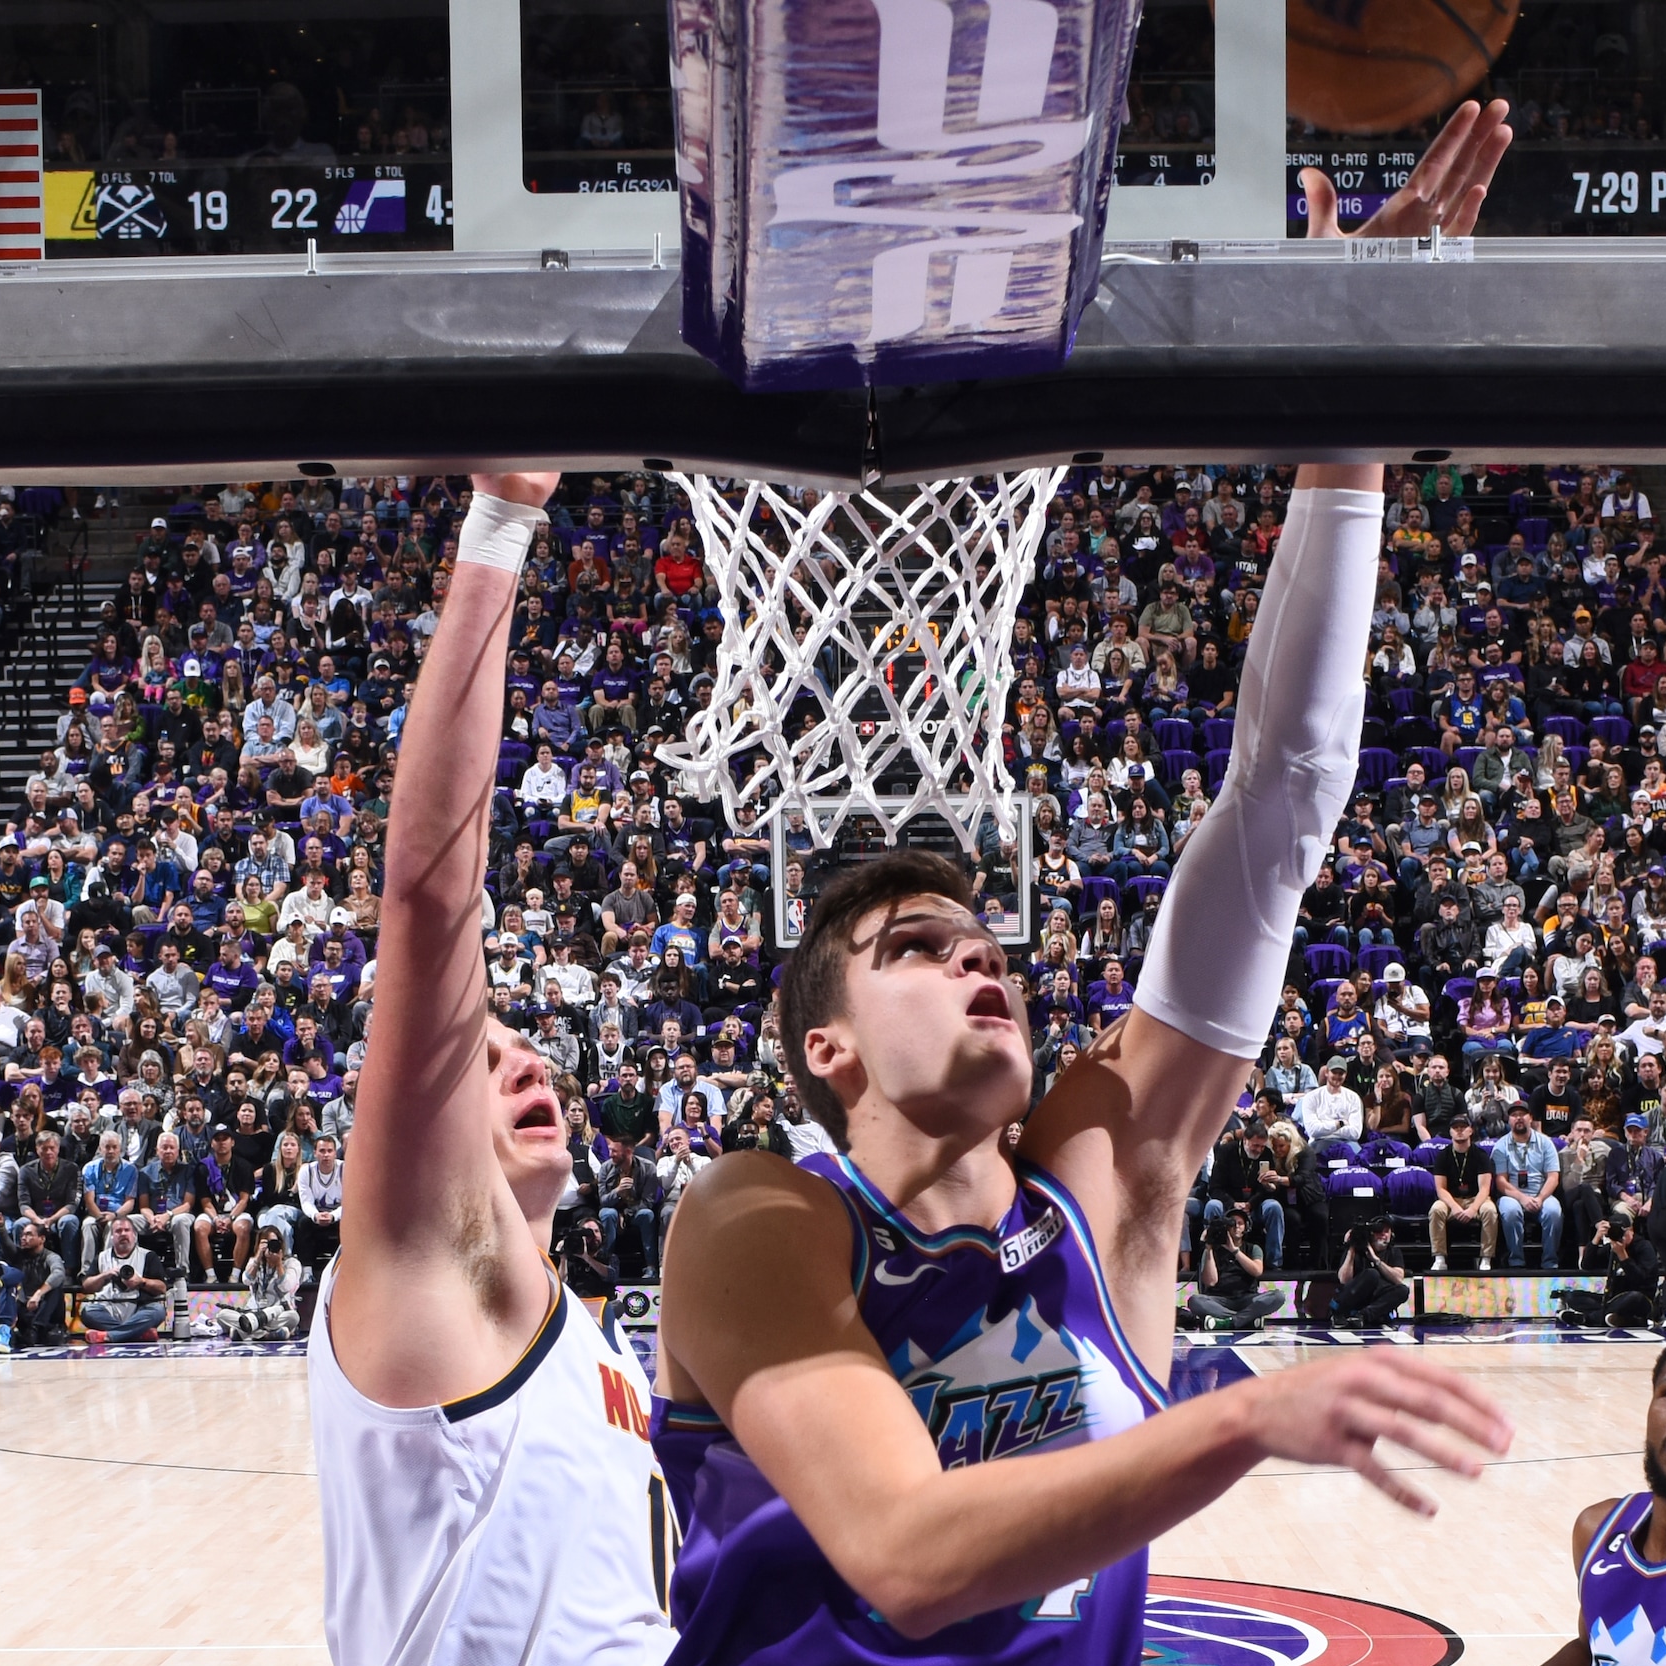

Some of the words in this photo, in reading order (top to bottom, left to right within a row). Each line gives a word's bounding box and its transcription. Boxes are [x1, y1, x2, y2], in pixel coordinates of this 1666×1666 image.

[1149, 156, 1171, 167] STL
[1285, 153, 1323, 166] BENCH
[325, 167, 332, 179] 5
[335, 167, 355, 179] FLS
[375, 166, 382, 177] 6
[384, 166, 404, 178] TOL
[617, 162, 632, 174] FG
[110, 173, 132, 184] FLS
[149, 172, 156, 183] 7
[159, 172, 177, 184] TOL
[1153, 173, 1166, 186] 4
[1334, 171, 1365, 188] 107
[1382, 171, 1408, 188] 116
[1573, 171, 1640, 215] 7:29
[188, 190, 228, 231] 19
[271, 188, 318, 229] 22
[1337, 198, 1362, 215] 116
[1235, 560, 1258, 573] UTAH
[1640, 1099, 1661, 1112] UTA
[1546, 1109, 1569, 1122] UTAH
[1026, 1216, 1063, 1256] FIGHT
[1003, 1240, 1021, 1268] 5
[1608, 1533, 1625, 1552] 6
